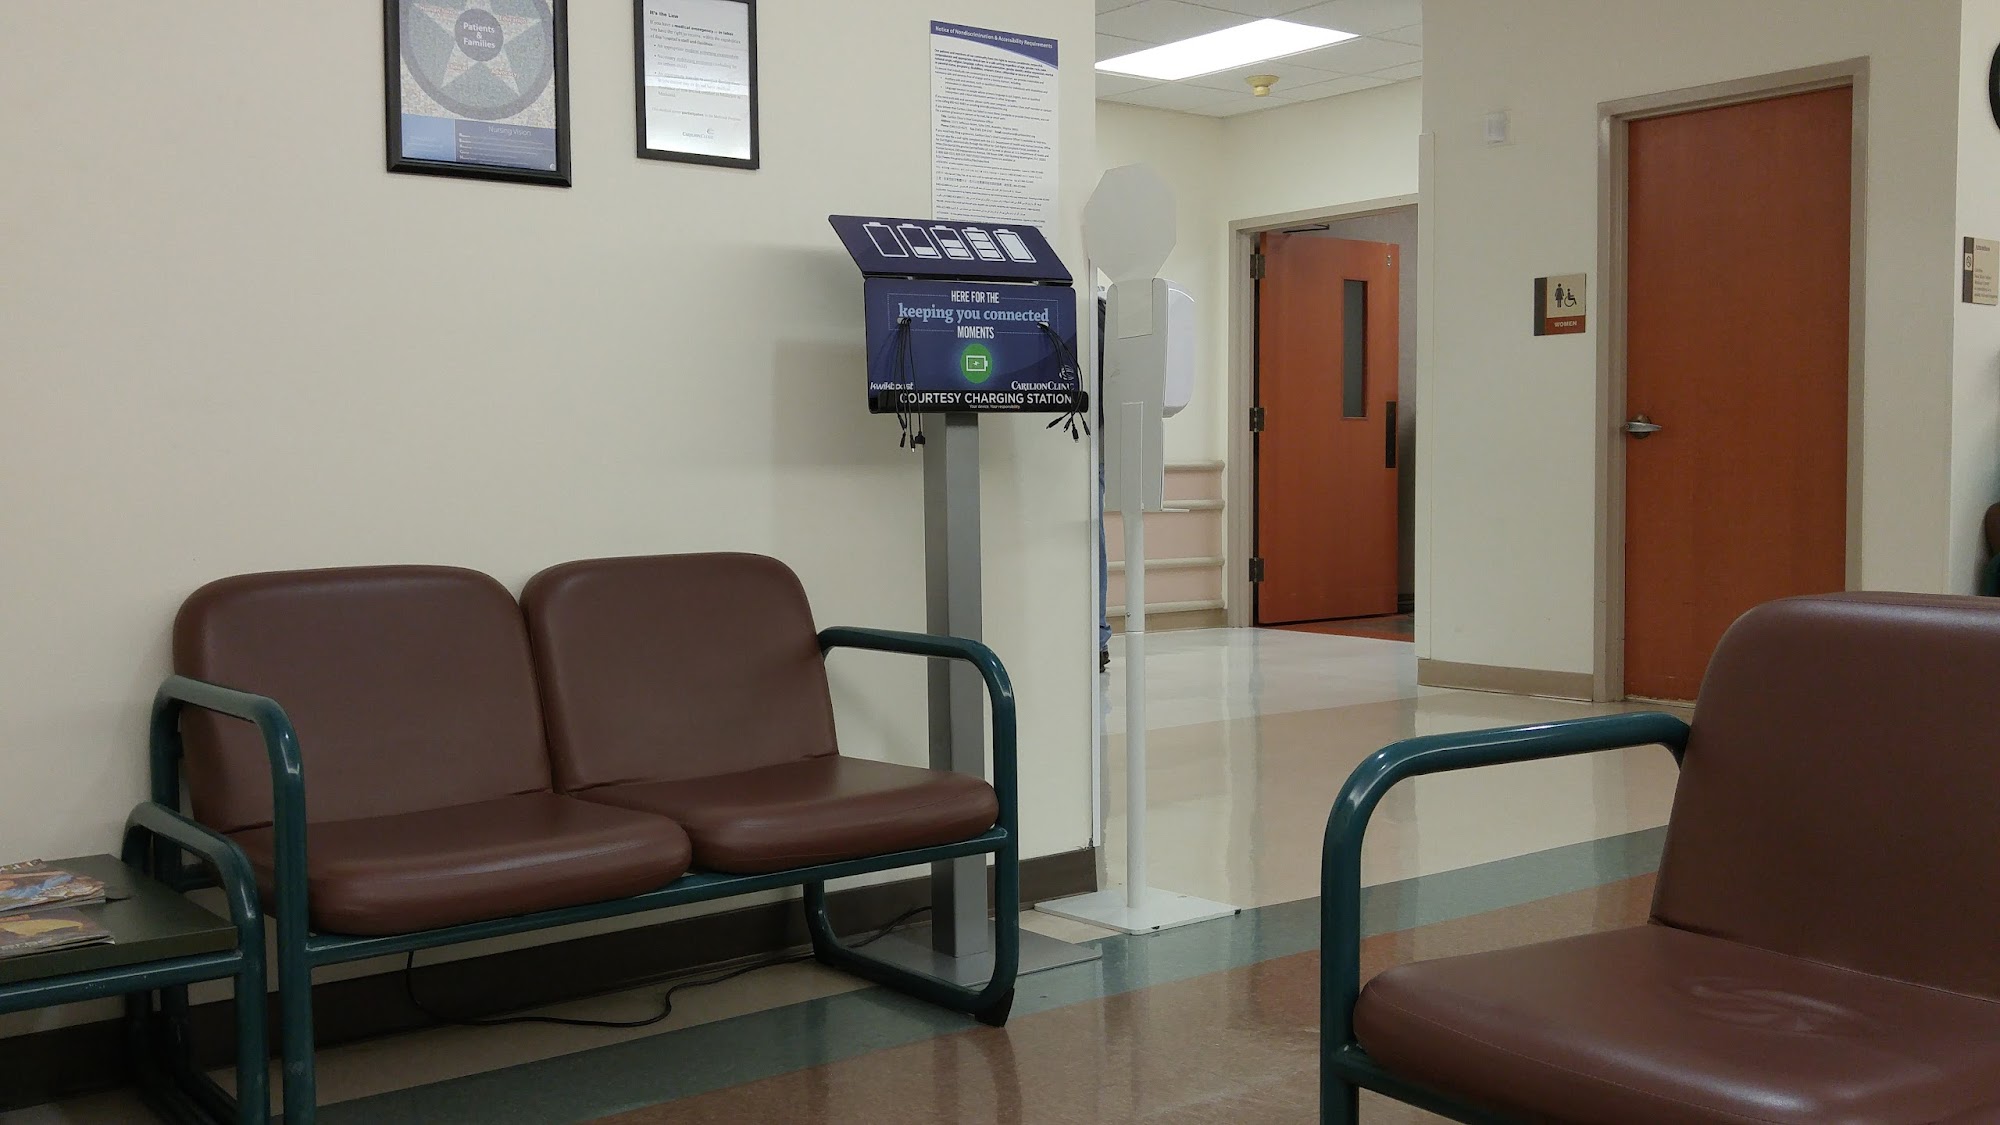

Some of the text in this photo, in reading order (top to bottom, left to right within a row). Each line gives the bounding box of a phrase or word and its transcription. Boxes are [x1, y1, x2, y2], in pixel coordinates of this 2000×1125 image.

[463, 22, 495, 34] Patients
[463, 38, 496, 49] Families
[955, 29, 993, 40] Nondiscrimination
[998, 35, 1023, 45] Accessibility
[1024, 40, 1053, 49] Requirements
[488, 126, 531, 136] Nursing Vision
[951, 290, 1000, 304] HERE FOR THE
[898, 303, 1049, 324] keeping you connected
[957, 326, 995, 339] MOMENTS
[900, 393, 1072, 404] COURTESY CHARGING STATION
